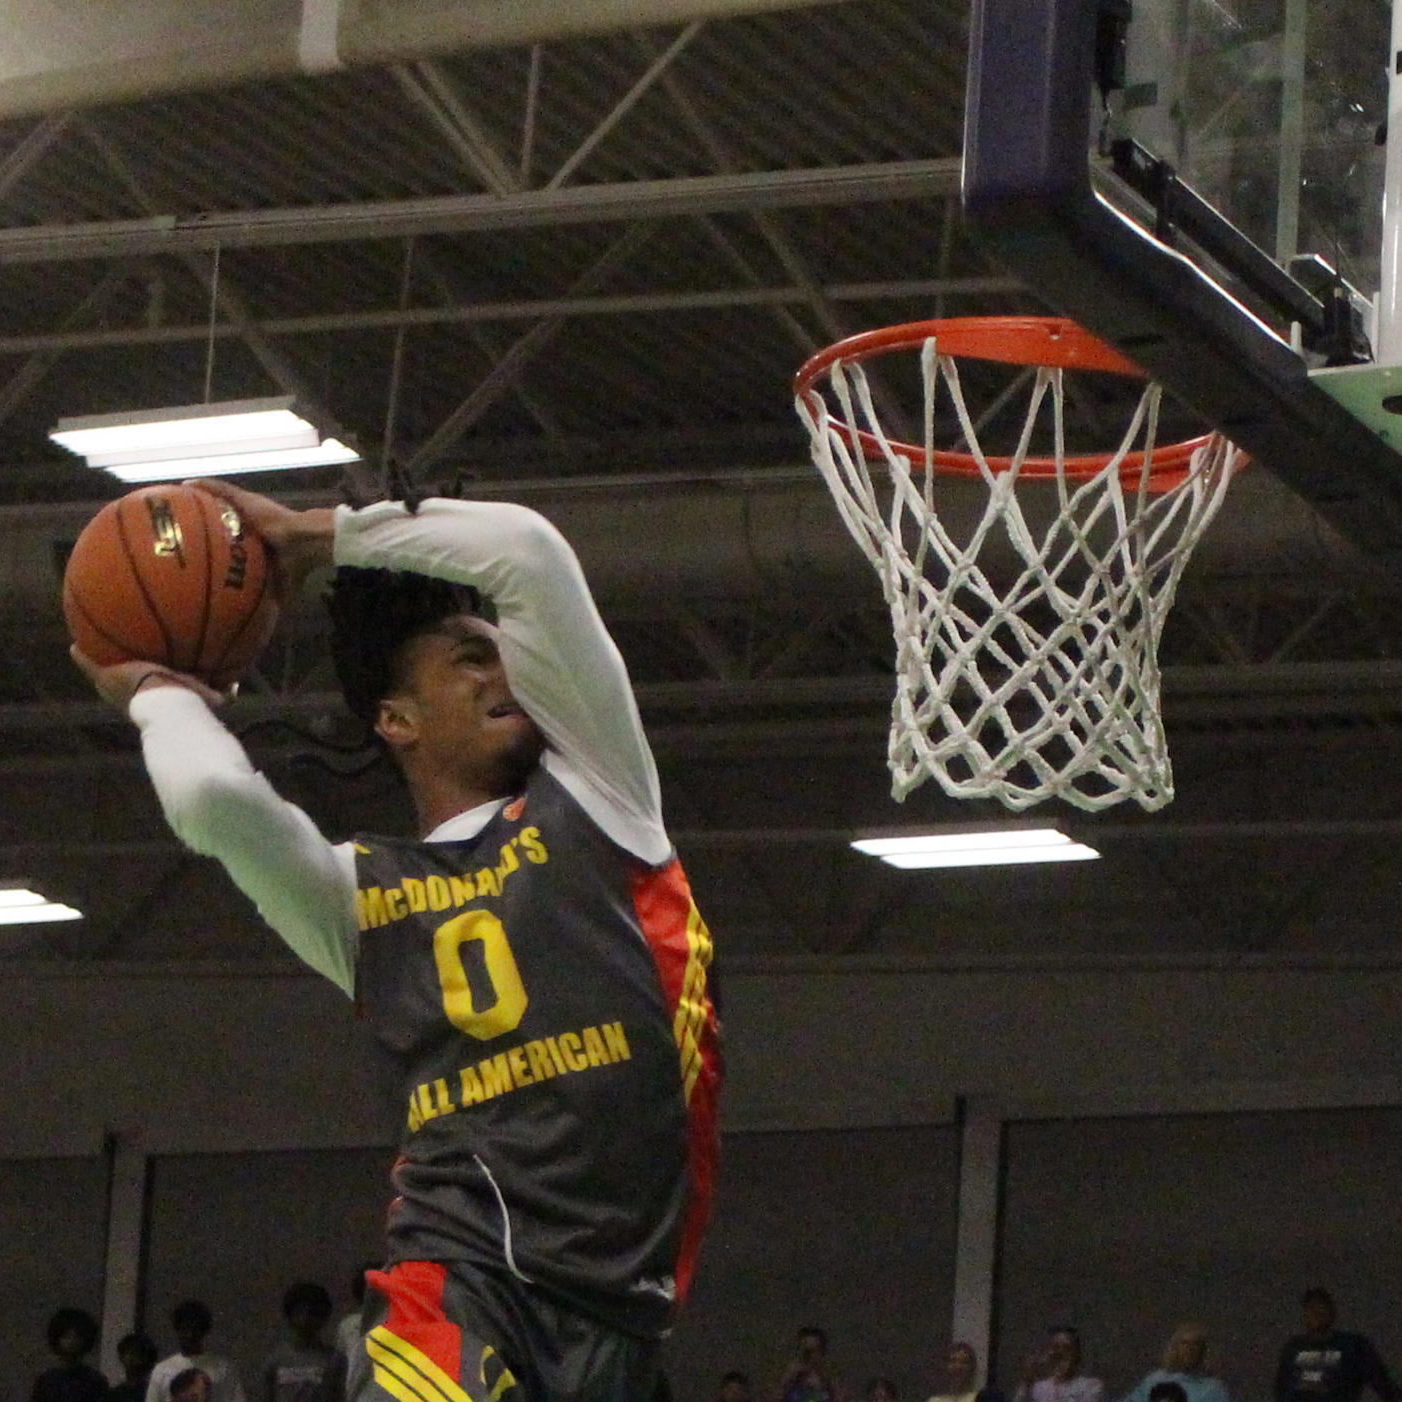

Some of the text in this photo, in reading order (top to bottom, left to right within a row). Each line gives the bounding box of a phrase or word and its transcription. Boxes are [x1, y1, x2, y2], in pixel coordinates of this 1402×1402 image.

[356, 826, 549, 931] McDONAD'S
[433, 909, 529, 1041] 0
[459, 1021, 632, 1107] AMERICAN
